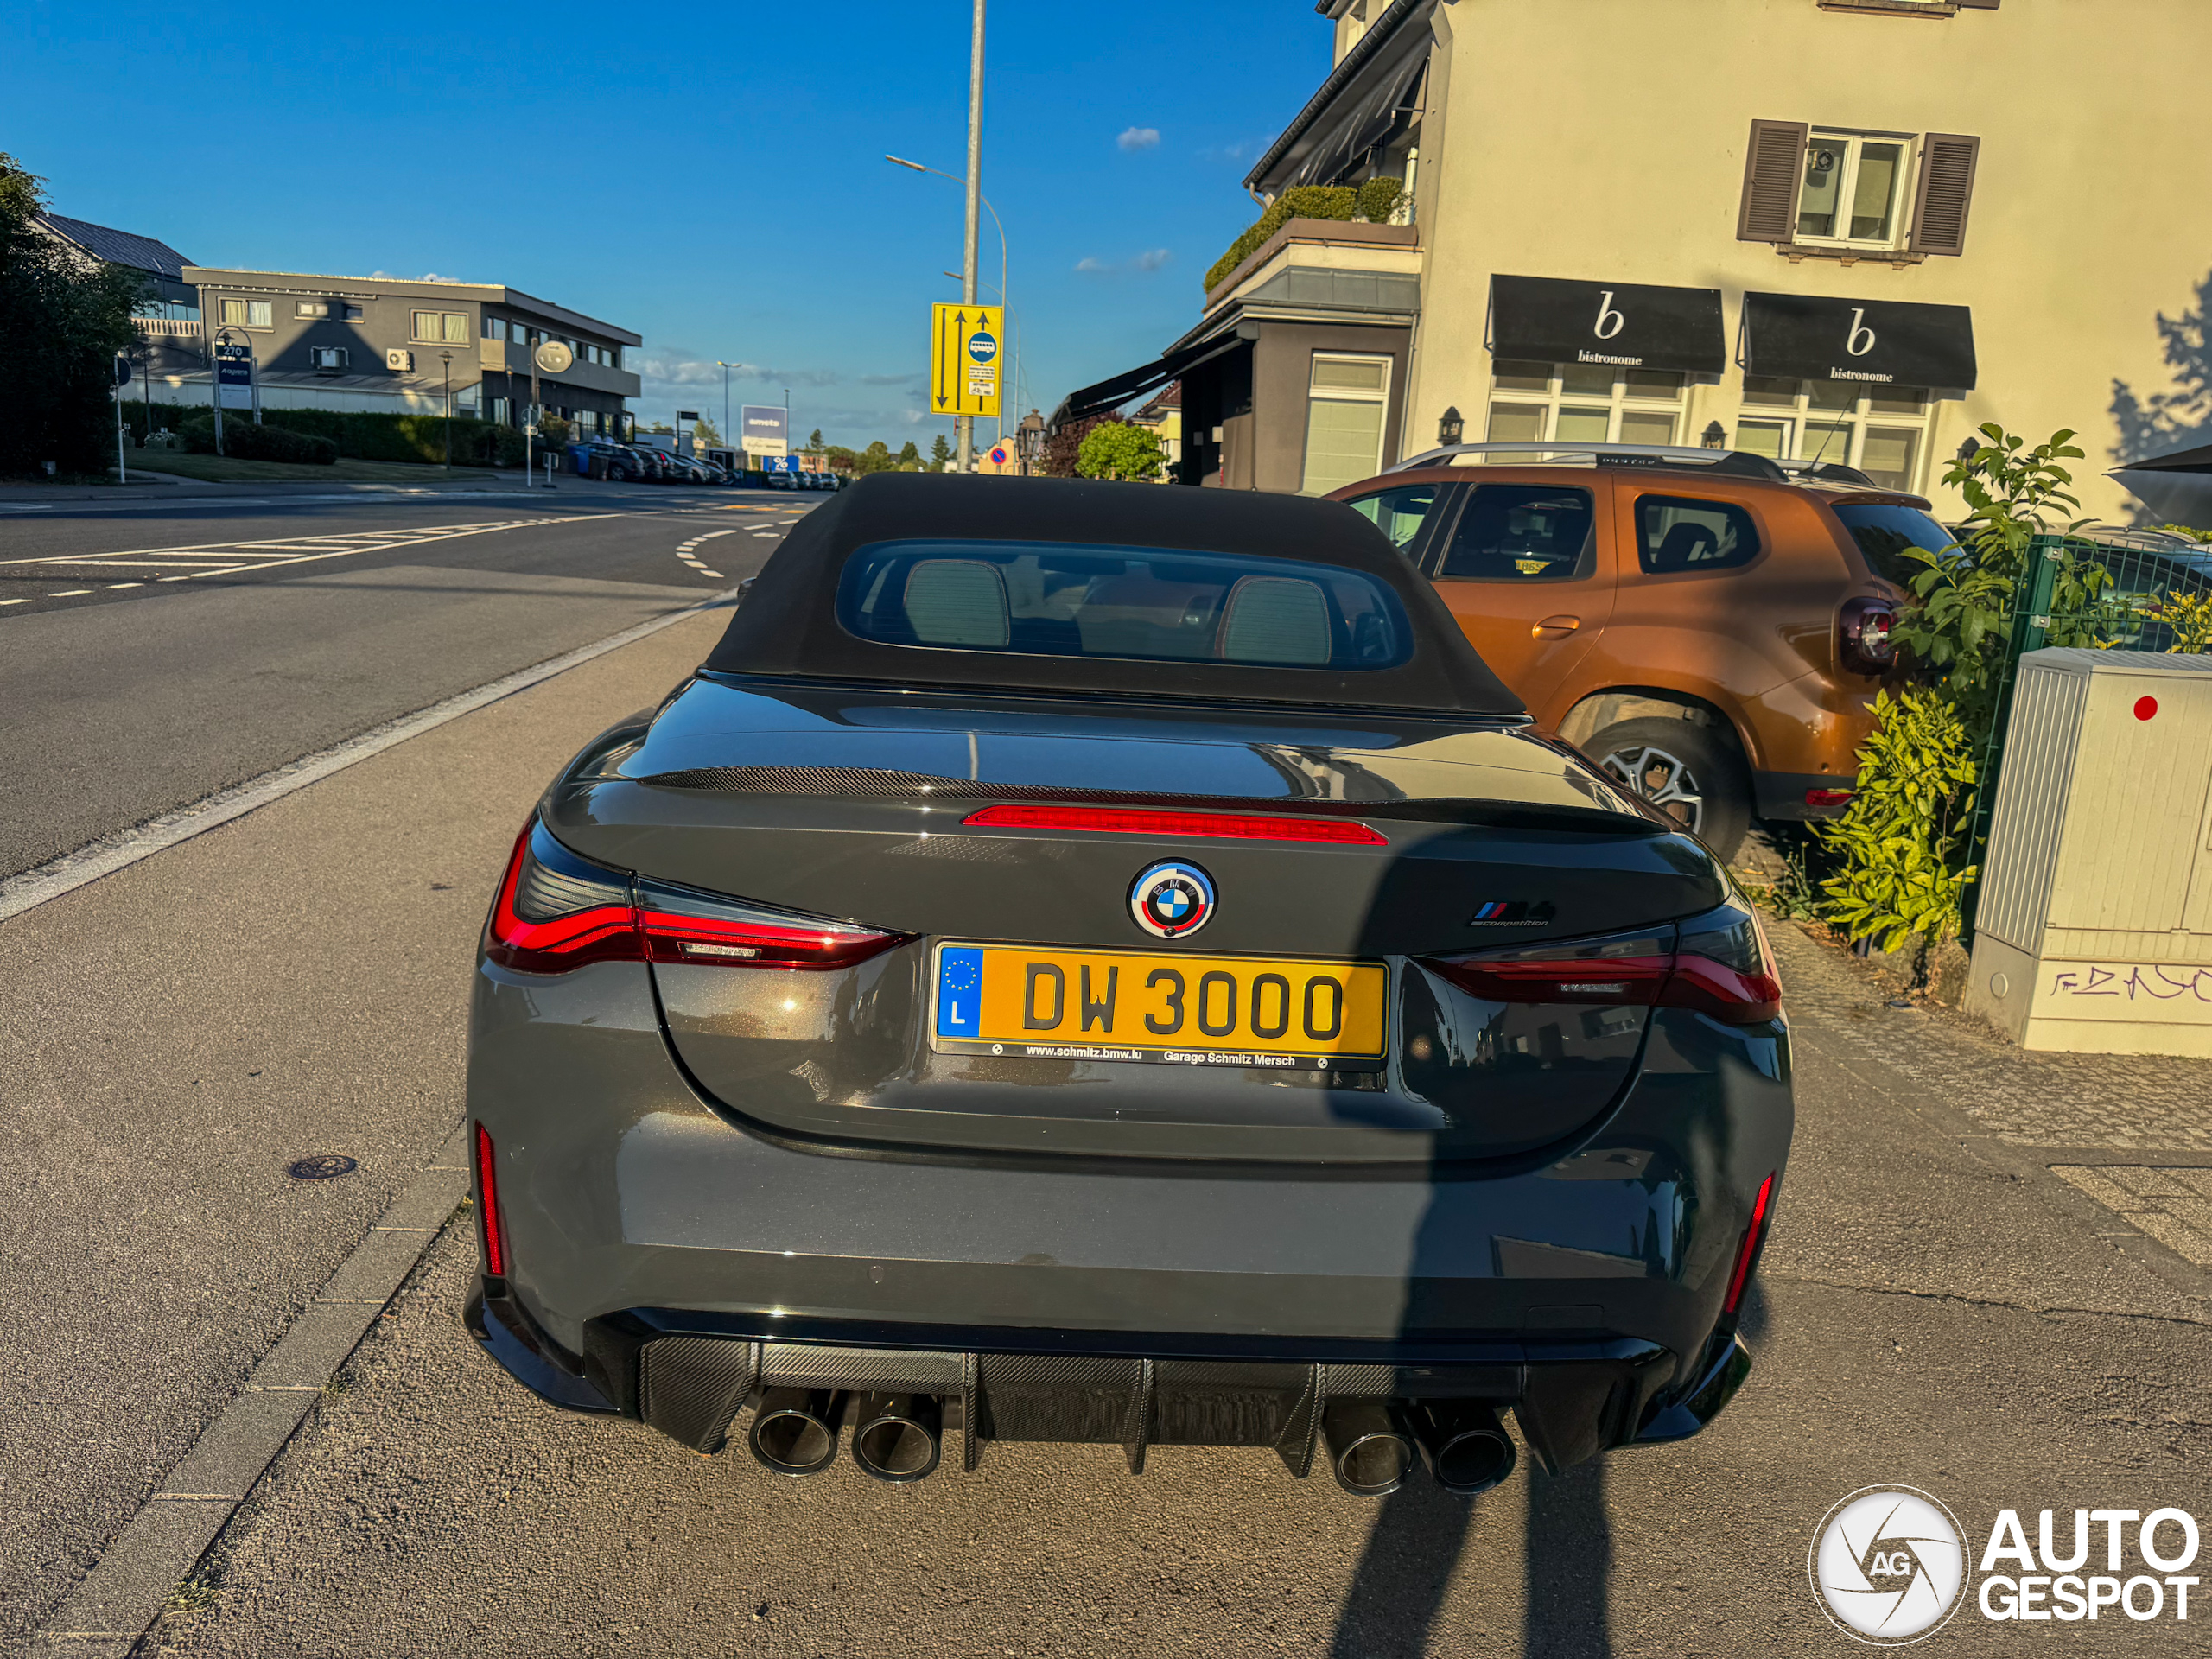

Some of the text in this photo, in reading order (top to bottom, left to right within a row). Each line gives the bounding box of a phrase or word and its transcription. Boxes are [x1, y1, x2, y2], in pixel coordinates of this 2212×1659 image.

[1593, 290, 1625, 340] b
[1846, 307, 1876, 357] b
[224, 346, 243, 356] 270
[1577, 349, 1643, 366] bistronome
[1829, 366, 1894, 383] bistronome
[1152, 880, 1198, 898] BMW
[1022, 963, 1343, 1042] DW 3000
[950, 1001, 966, 1025] L
[1026, 1044, 1142, 1060] www.schmitz.bmw.lu
[1163, 1050, 1295, 1066] Garage Schmitz Mersch
